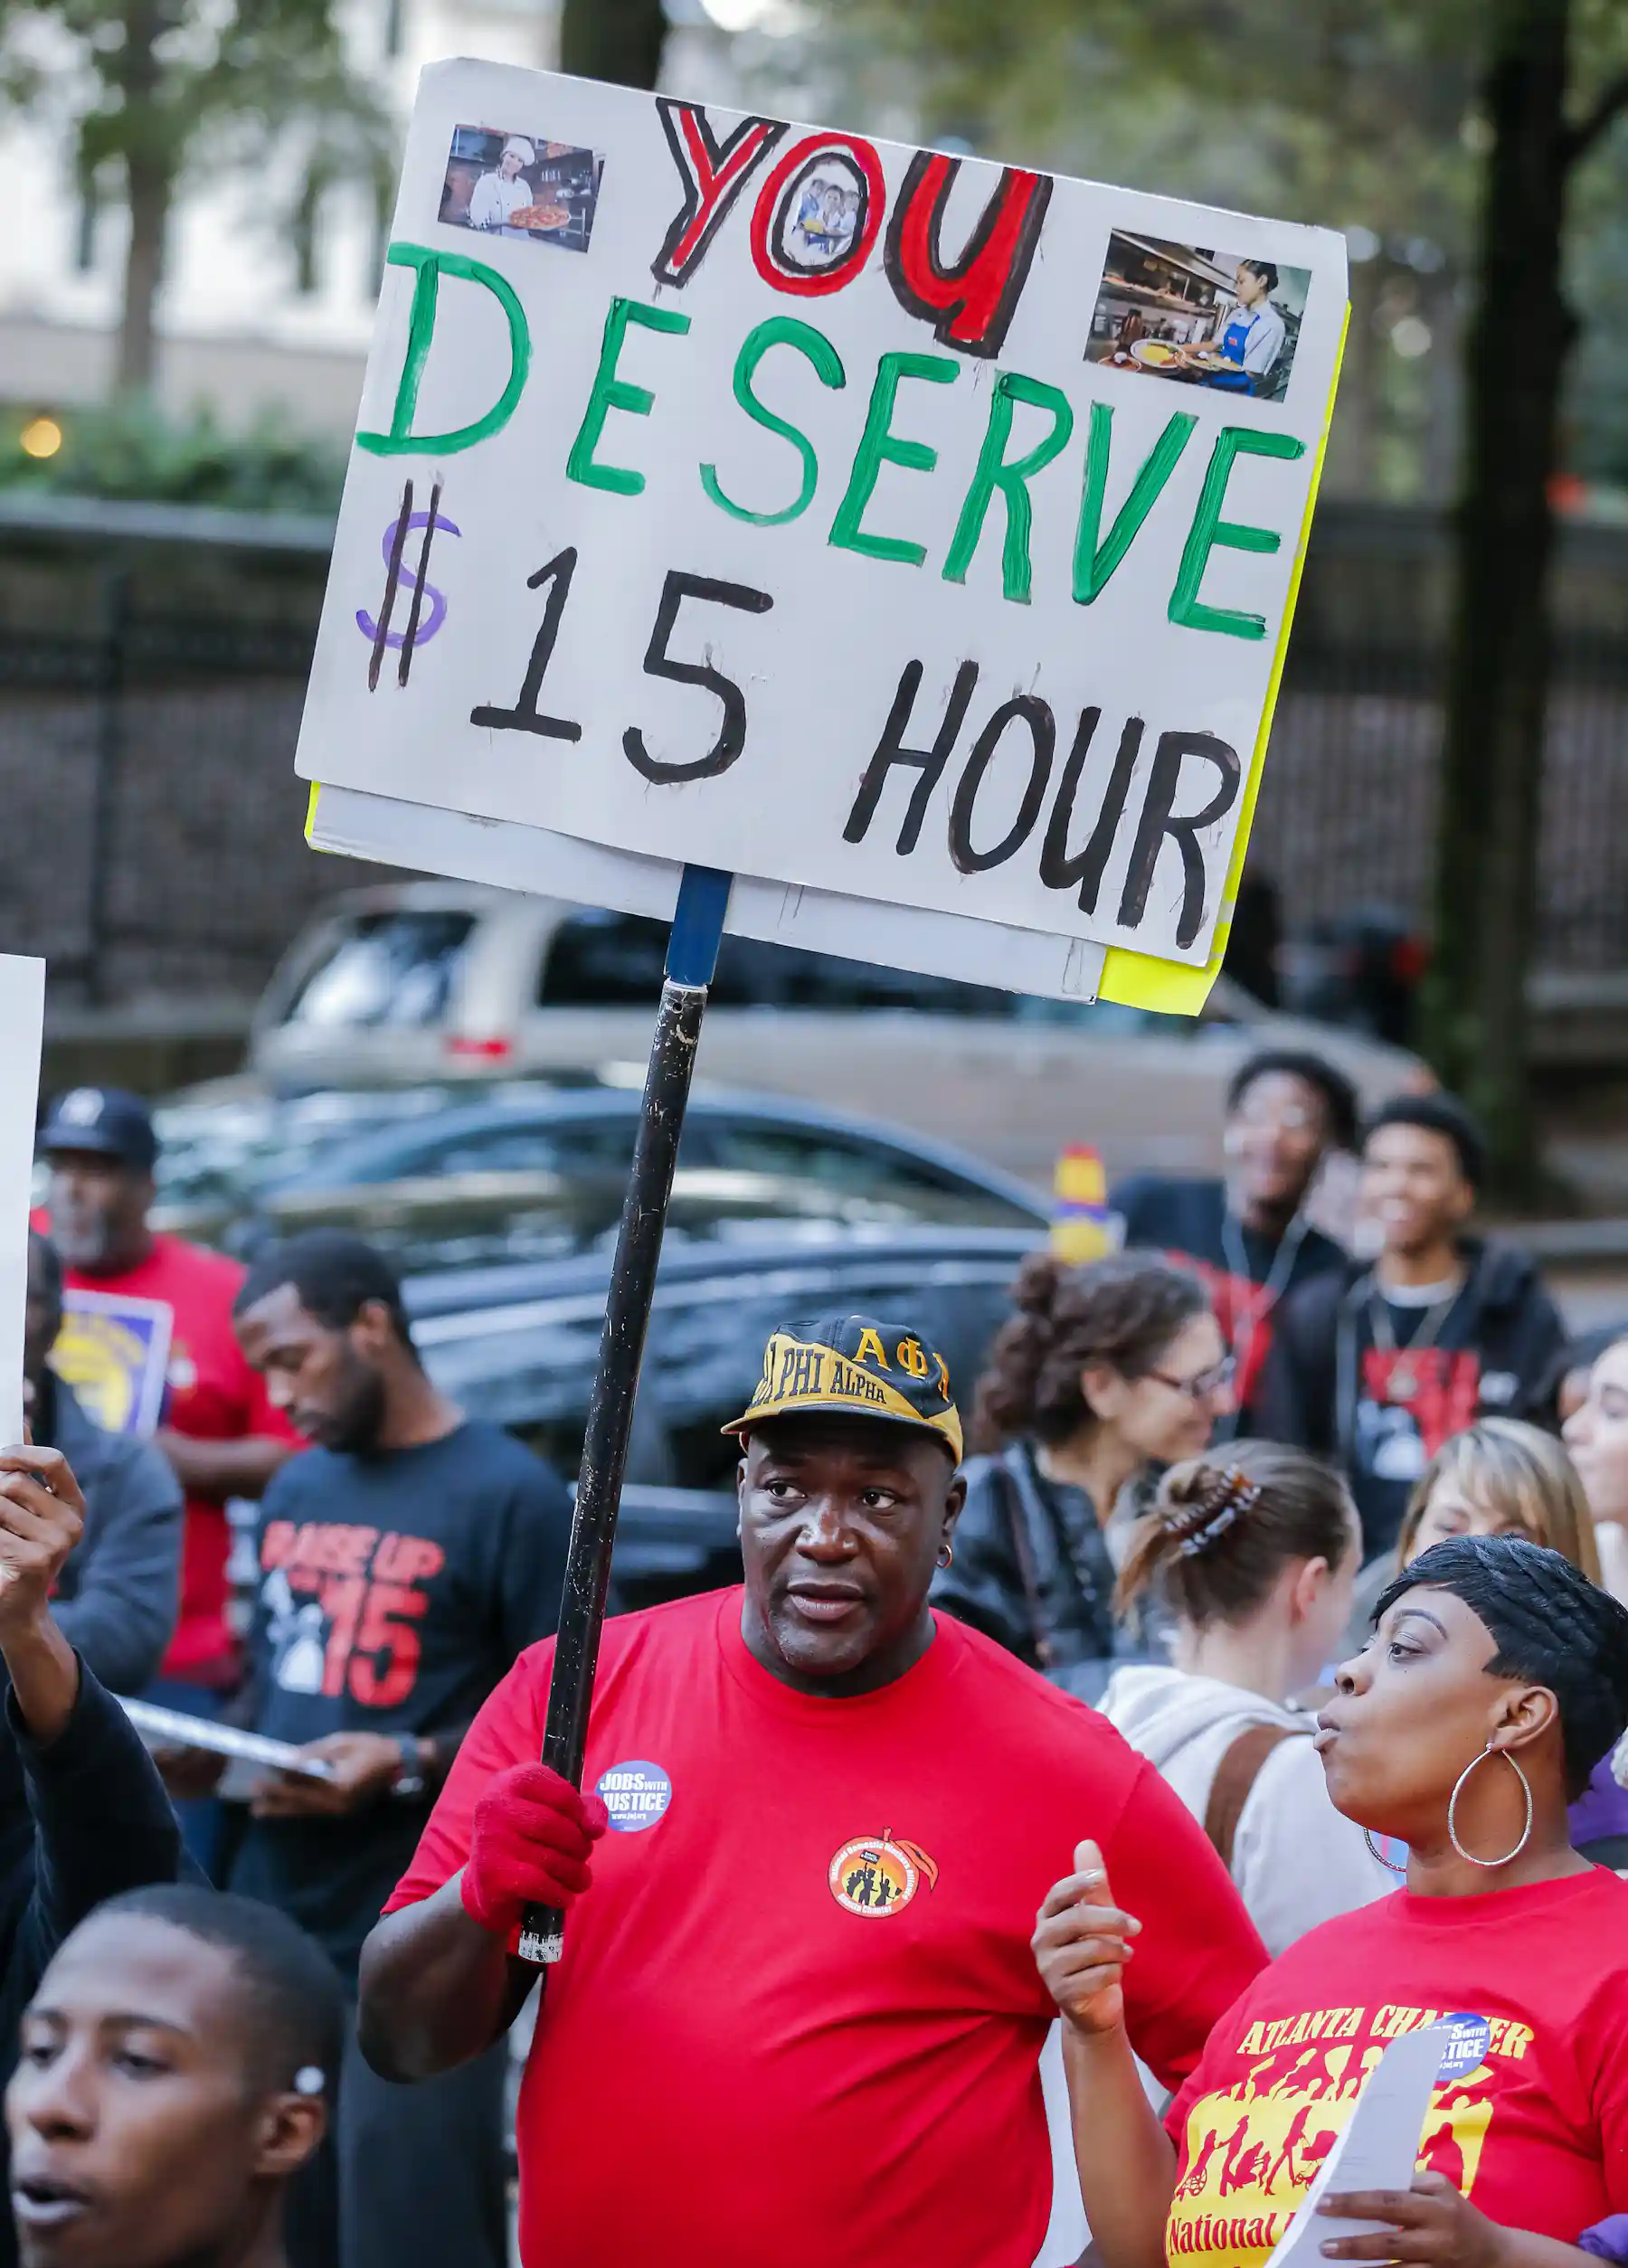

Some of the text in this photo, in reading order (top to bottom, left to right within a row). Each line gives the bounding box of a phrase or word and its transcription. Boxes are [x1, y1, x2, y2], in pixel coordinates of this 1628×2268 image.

[650, 97, 1053, 359] YOU
[357, 241, 1305, 639] DESERVE
[843, 660, 1240, 950] HOUR
[774, 1347, 825, 1401] PHI
[830, 1361, 886, 1403] ALPHA
[600, 1773, 645, 1791] JOBS
[1236, 2004, 1535, 2059] ATLANTA CHAER
[1442, 2038, 1485, 2061] TICE
[1169, 2213, 1277, 2256] National
